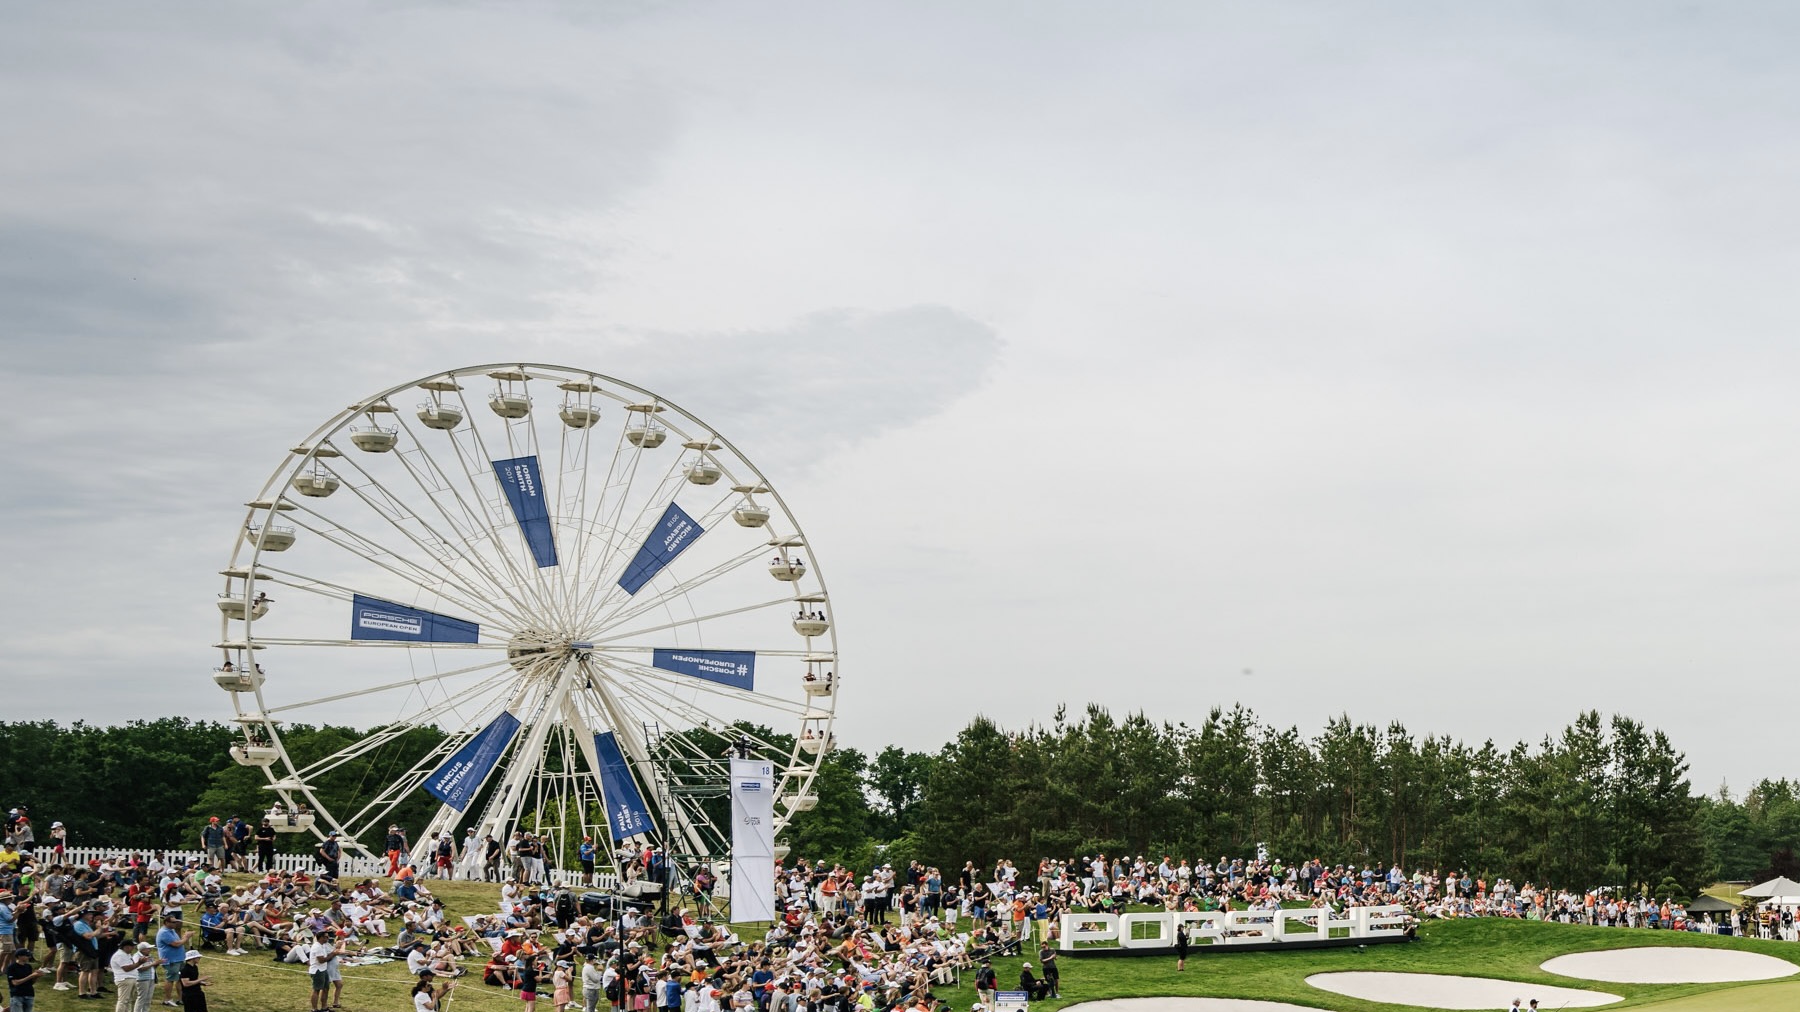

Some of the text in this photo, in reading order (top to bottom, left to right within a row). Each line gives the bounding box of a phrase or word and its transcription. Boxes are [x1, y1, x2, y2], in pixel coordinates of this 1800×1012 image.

[505, 466, 515, 484] 2017
[514, 465, 527, 492] SMITH
[521, 464, 536, 497] JORDAN
[667, 513, 680, 528] 2018
[663, 520, 687, 546] McEVOY
[667, 524, 692, 552] RICHARD
[363, 612, 418, 624] PORSCHE
[363, 620, 418, 632] EUROPEAN OPEN
[672, 654, 735, 668] EUROPEANOPEN
[698, 664, 735, 675] PORSCHE
[435, 761, 463, 791] MARCUS
[442, 760, 474, 796] ARMITAGE
[762, 766, 770, 775] 18
[451, 786, 464, 801] 2021
[616, 811, 627, 832] PAUL
[620, 803, 633, 830] CASEY
[1060, 905, 1404, 950] PORSCHE
